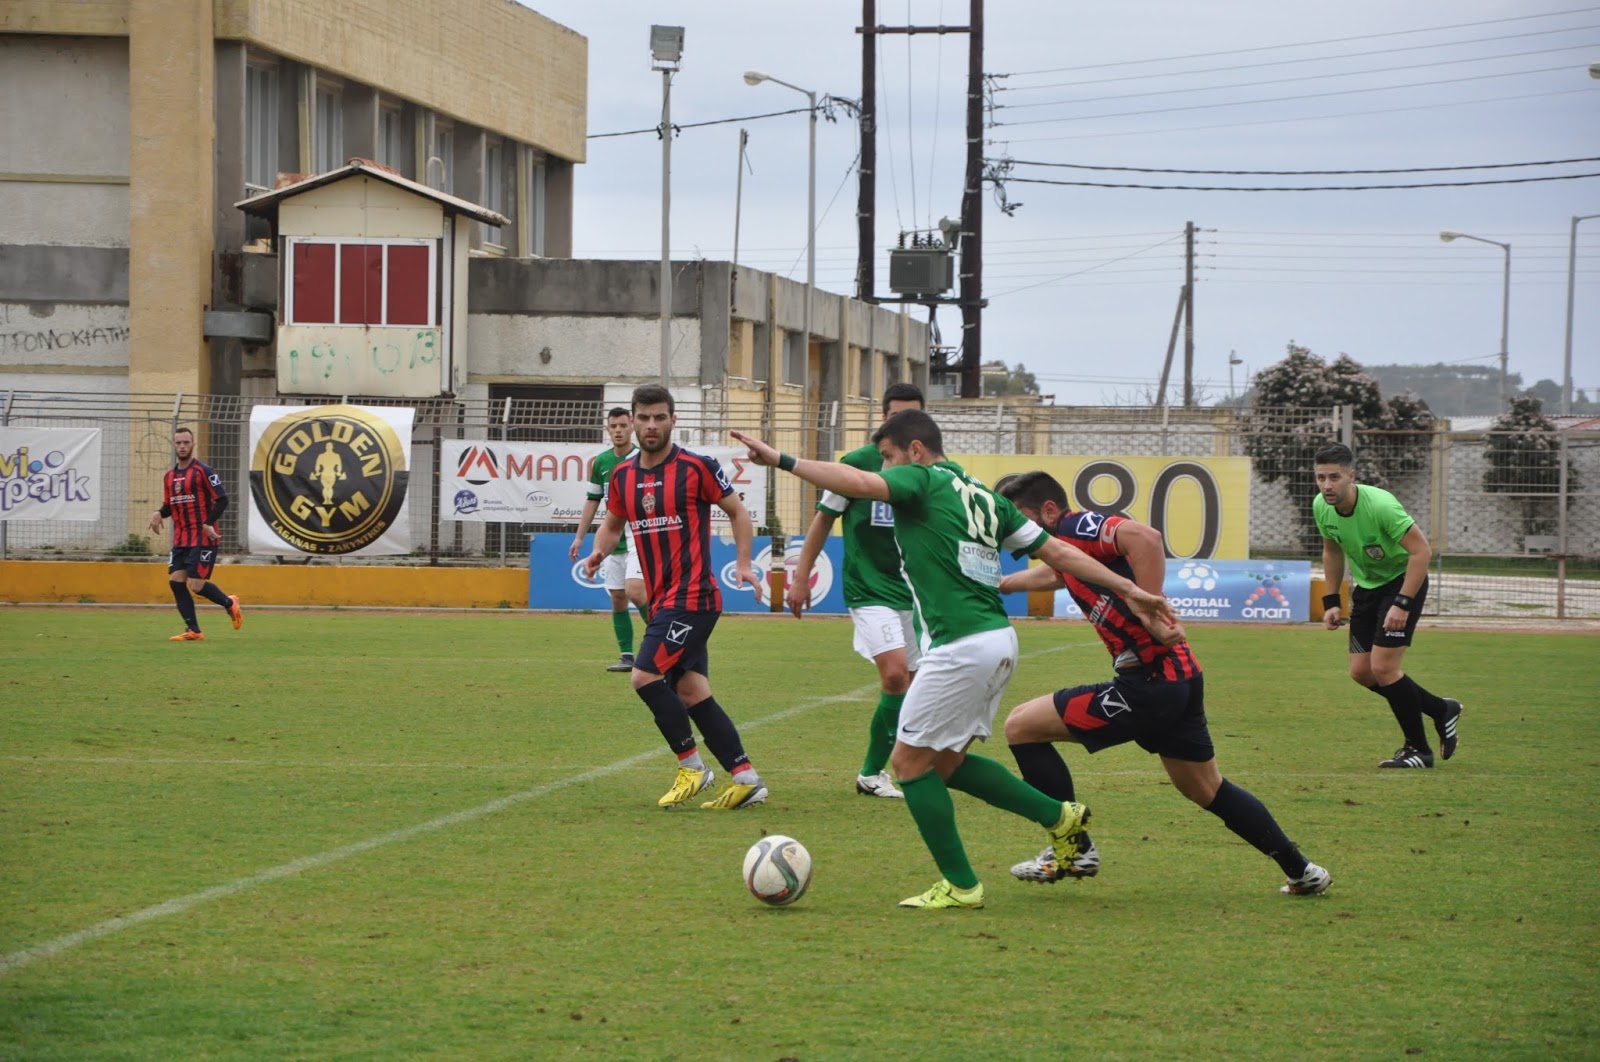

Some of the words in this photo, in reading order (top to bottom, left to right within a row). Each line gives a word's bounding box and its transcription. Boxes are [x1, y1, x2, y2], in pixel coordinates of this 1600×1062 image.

[274, 421, 383, 478] GOLDEN
[290, 490, 371, 527] GYM
[553, 507, 583, 517] Δρόμο
[874, 501, 895, 521] EU
[952, 476, 999, 549] 10
[993, 460, 1222, 560] 80
[271, 519, 318, 552] LAGANAS
[327, 519, 386, 553] ZAKYNTHOS
